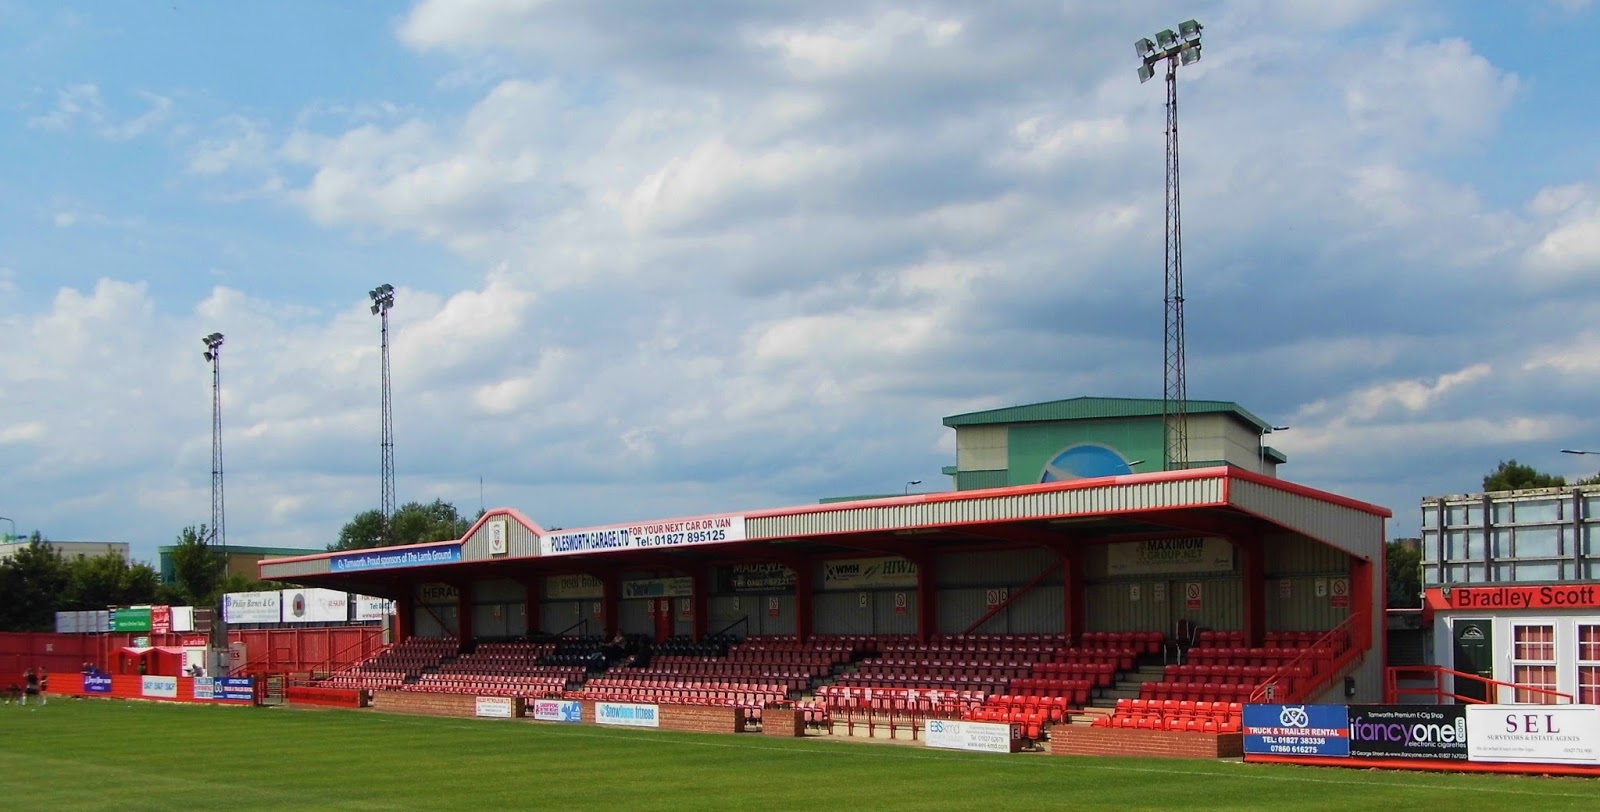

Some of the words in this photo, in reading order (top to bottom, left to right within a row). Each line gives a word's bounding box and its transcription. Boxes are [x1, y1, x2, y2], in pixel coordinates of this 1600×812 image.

[628, 526, 642, 536] FOR
[644, 525, 664, 535] YOUR
[665, 522, 684, 533] NEXT
[685, 521, 701, 531] CAR
[702, 519, 713, 529] OR
[714, 518, 731, 528] VAN
[551, 532, 590, 552] POLESWORTH
[591, 530, 616, 549] GARAGE
[617, 529, 630, 546] LTD
[635, 536, 652, 547] Tel:
[654, 533, 685, 546] 01827
[687, 529, 726, 542] 895125
[1147, 538, 1203, 550] MAXIMUM
[367, 555, 380, 566] Proud
[381, 555, 400, 566] sponsors
[400, 552, 408, 563] of
[408, 551, 418, 562] The
[417, 550, 432, 561] Lamb
[431, 548, 452, 560] Ground
[835, 564, 860, 574] WMH
[423, 587, 460, 598] HERAL
[1318, 585, 1323, 594] F
[861, 595, 866, 604] C
[1002, 591, 1007, 600] D
[1458, 588, 1533, 608] Bradley
[1540, 586, 1594, 605] Scott
[1267, 687, 1271, 698] F
[1506, 714, 1560, 733] SEL
[1013, 728, 1018, 738] E
[1349, 716, 1456, 746] ifancyone
[1278, 736, 1298, 744] 01827
[1300, 737, 1325, 745] 383336
